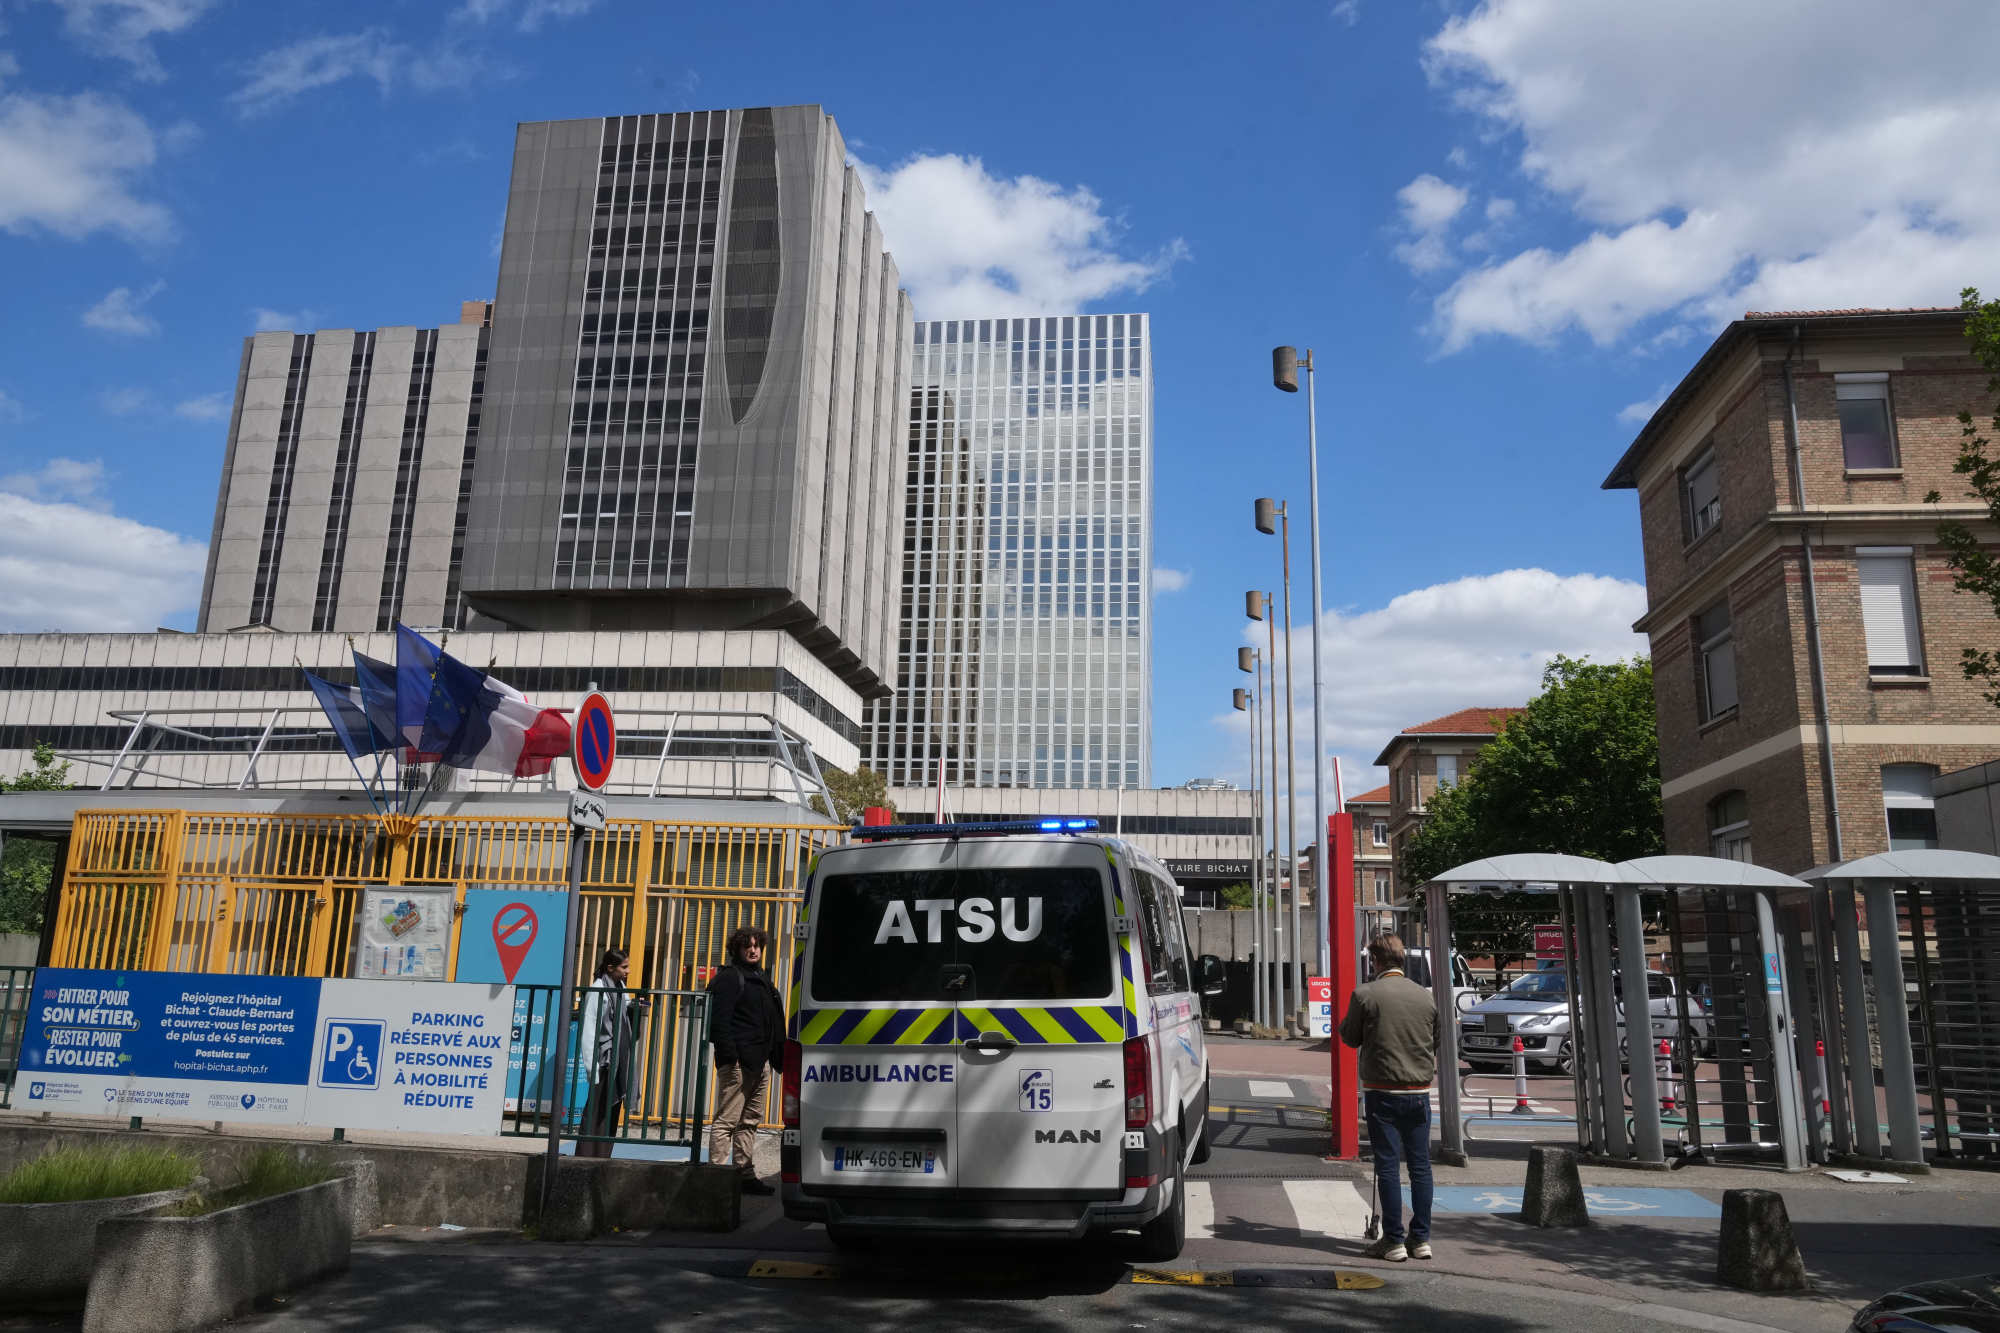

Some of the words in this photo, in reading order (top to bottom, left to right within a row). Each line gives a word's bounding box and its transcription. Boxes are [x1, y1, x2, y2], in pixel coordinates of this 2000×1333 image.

[1168, 864, 1201, 872] TAIRE
[1207, 864, 1249, 873] BICHAT
[873, 896, 1043, 945] ATSU
[57, 988, 98, 1004] ENTRER
[99, 990, 130, 1006] POUR
[181, 992, 234, 1004] Rejoignez
[41, 1007, 75, 1023] SON
[77, 1005, 137, 1028] MÉTIER,
[165, 1004, 200, 1016] Bichat
[208, 1007, 294, 1019] Claude-Bernard
[411, 1012, 484, 1028] PARKING
[160, 1018, 172, 1027] et
[174, 1020, 239, 1030] ouvrez-vous
[241, 1021, 256, 1030] les
[258, 1022, 295, 1033] portes
[50, 1029, 91, 1046] RESTER
[91, 1031, 122, 1047] POUR
[166, 1030, 180, 1040] de
[181, 1031, 205, 1043] plus
[207, 1032, 221, 1042] de
[223, 1033, 236, 1043] 45
[238, 1034, 285, 1045] services.
[328, 1026, 354, 1061] P
[390, 1029, 463, 1047] RÉSERVÉ
[466, 1035, 502, 1048] AUX
[45, 1045, 120, 1068] ÉVOLUER.
[195, 1049, 234, 1058] Postulez
[395, 1052, 493, 1069] PERSONNES
[174, 1060, 268, 1074] hopital-bichat.aphp.fr
[804, 1064, 954, 1083] AMBULANCE
[394, 1068, 406, 1085] À
[411, 1072, 488, 1089] MOBILITÉ
[403, 1090, 474, 1109] RÉDUITE
[1026, 1089, 1051, 1110] 15
[1035, 1130, 1101, 1143] MAN
[845, 1149, 922, 1169] HK-466-EN
